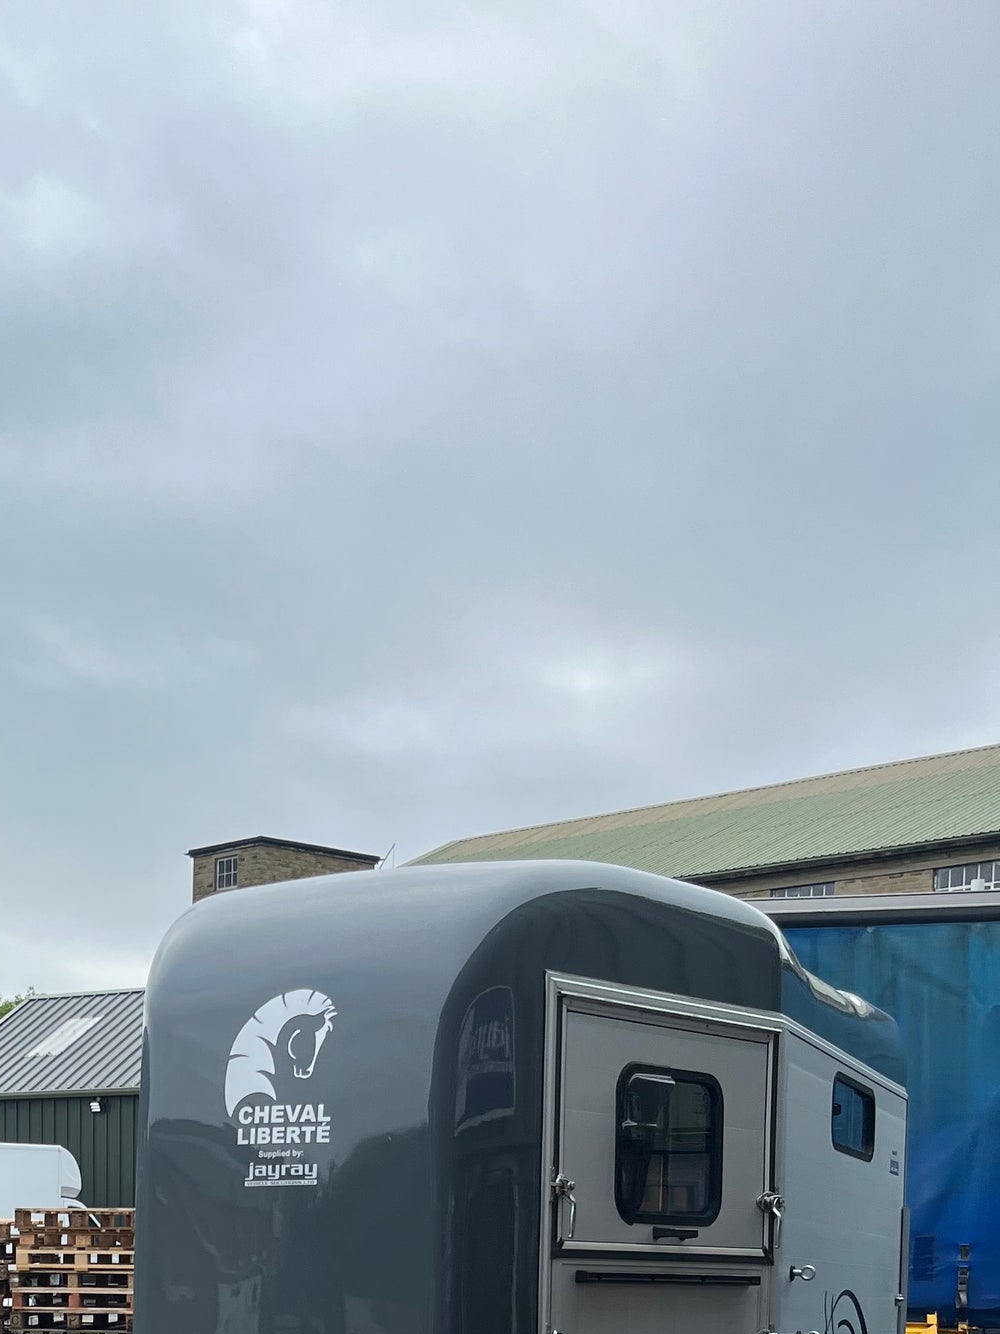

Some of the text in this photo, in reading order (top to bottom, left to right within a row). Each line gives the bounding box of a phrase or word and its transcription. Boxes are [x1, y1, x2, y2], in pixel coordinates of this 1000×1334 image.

[238, 1103, 331, 1125] CHEVAL
[237, 1122, 331, 1146] LIBERTÉ
[258, 1149, 305, 1159] Supplied by:
[244, 1162, 318, 1181] jayray
